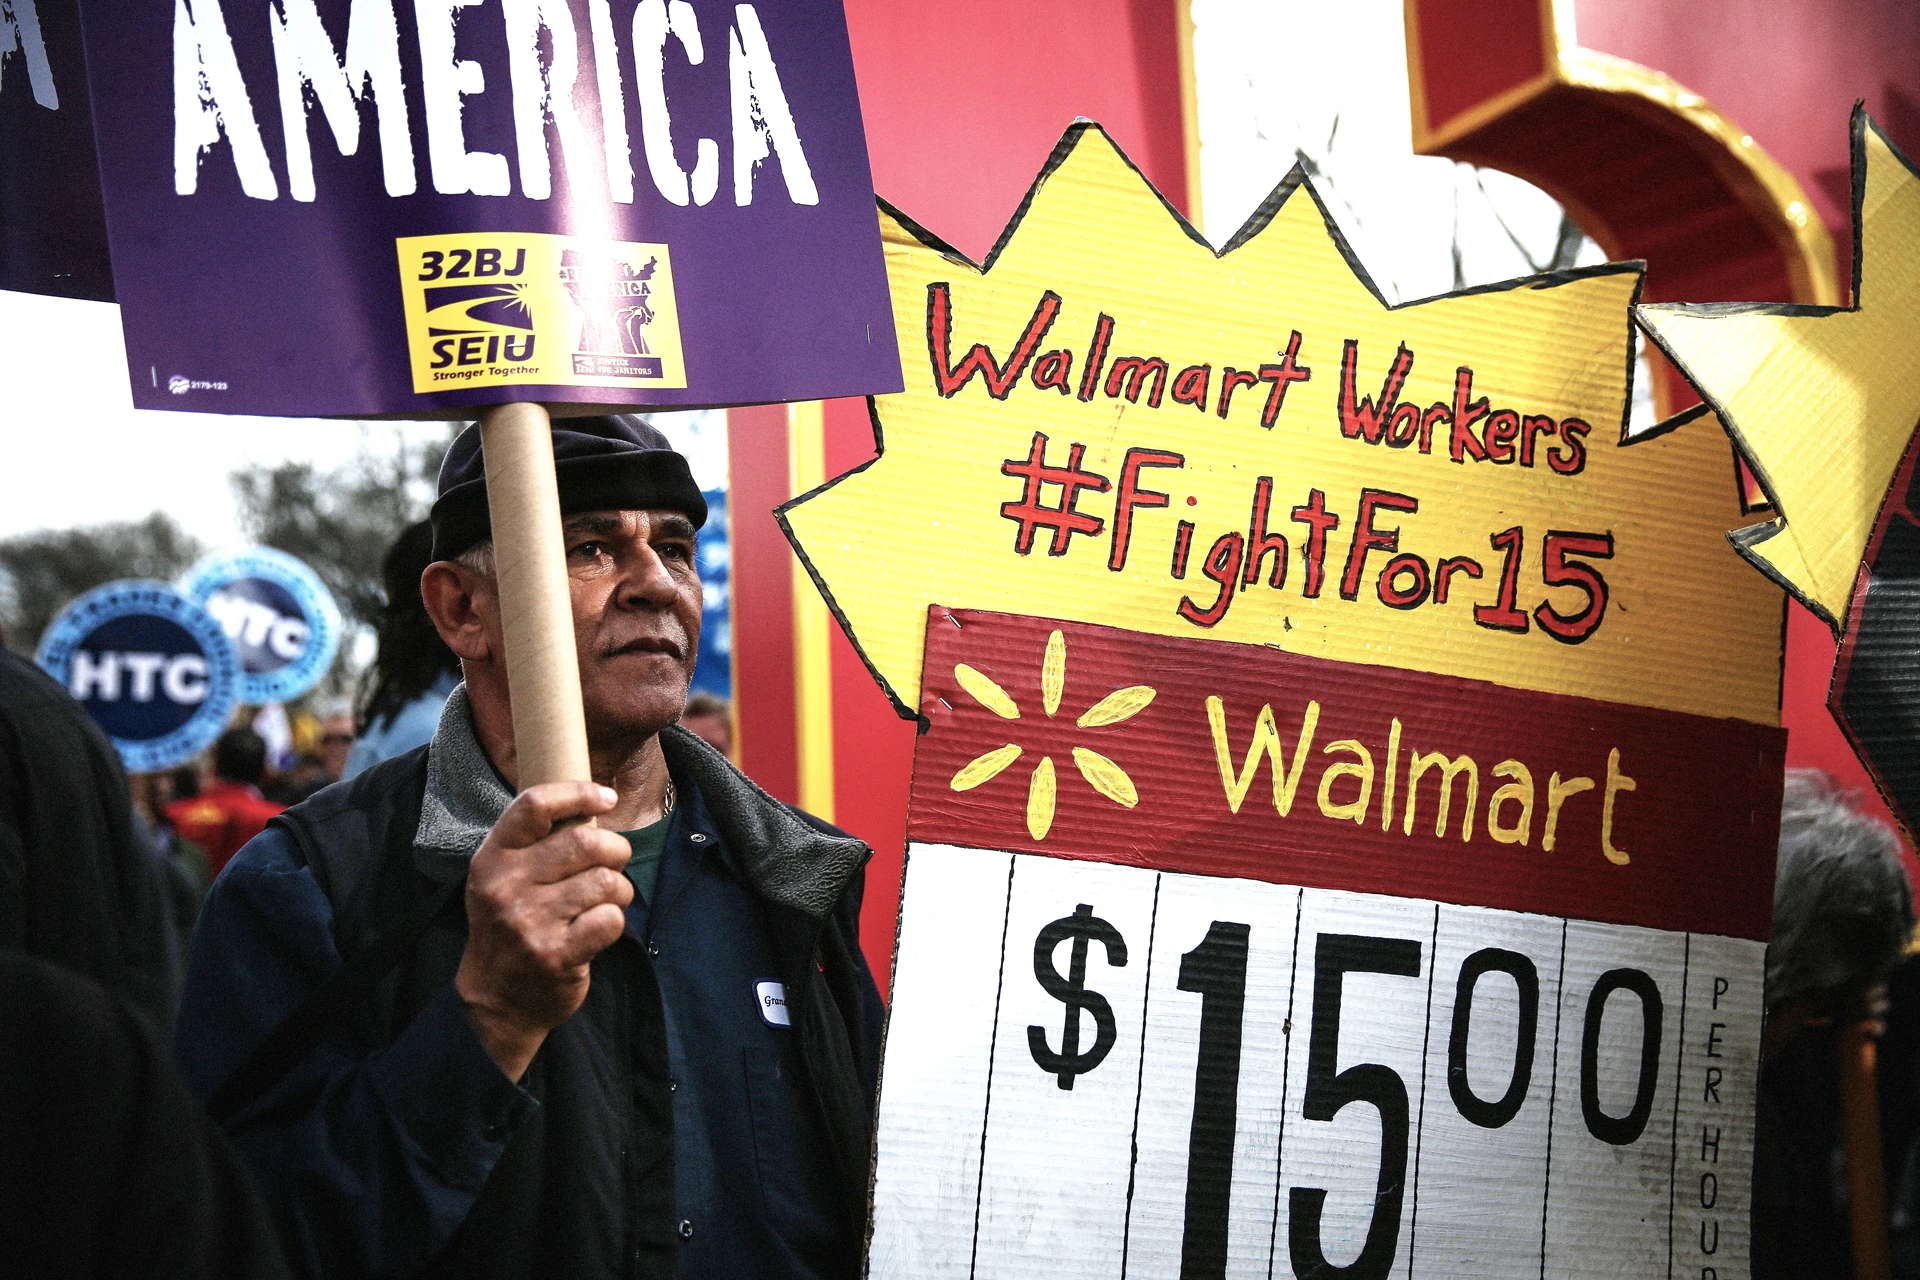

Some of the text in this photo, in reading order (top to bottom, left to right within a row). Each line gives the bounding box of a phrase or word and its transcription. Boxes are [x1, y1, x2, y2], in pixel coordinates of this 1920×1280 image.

[174, 0, 819, 207] AMERICA
[418, 248, 526, 281] 32BJ
[430, 335, 536, 369] SEIU
[433, 366, 540, 381] Stronger Together
[615, 366, 652, 375] JANITORS
[926, 282, 1592, 475] Walmart Workers
[1000, 431, 1615, 645] #FightFor15
[70, 650, 209, 706] HTC
[1206, 695, 1637, 866] Walmart
[1703, 977, 1728, 1103] PER
